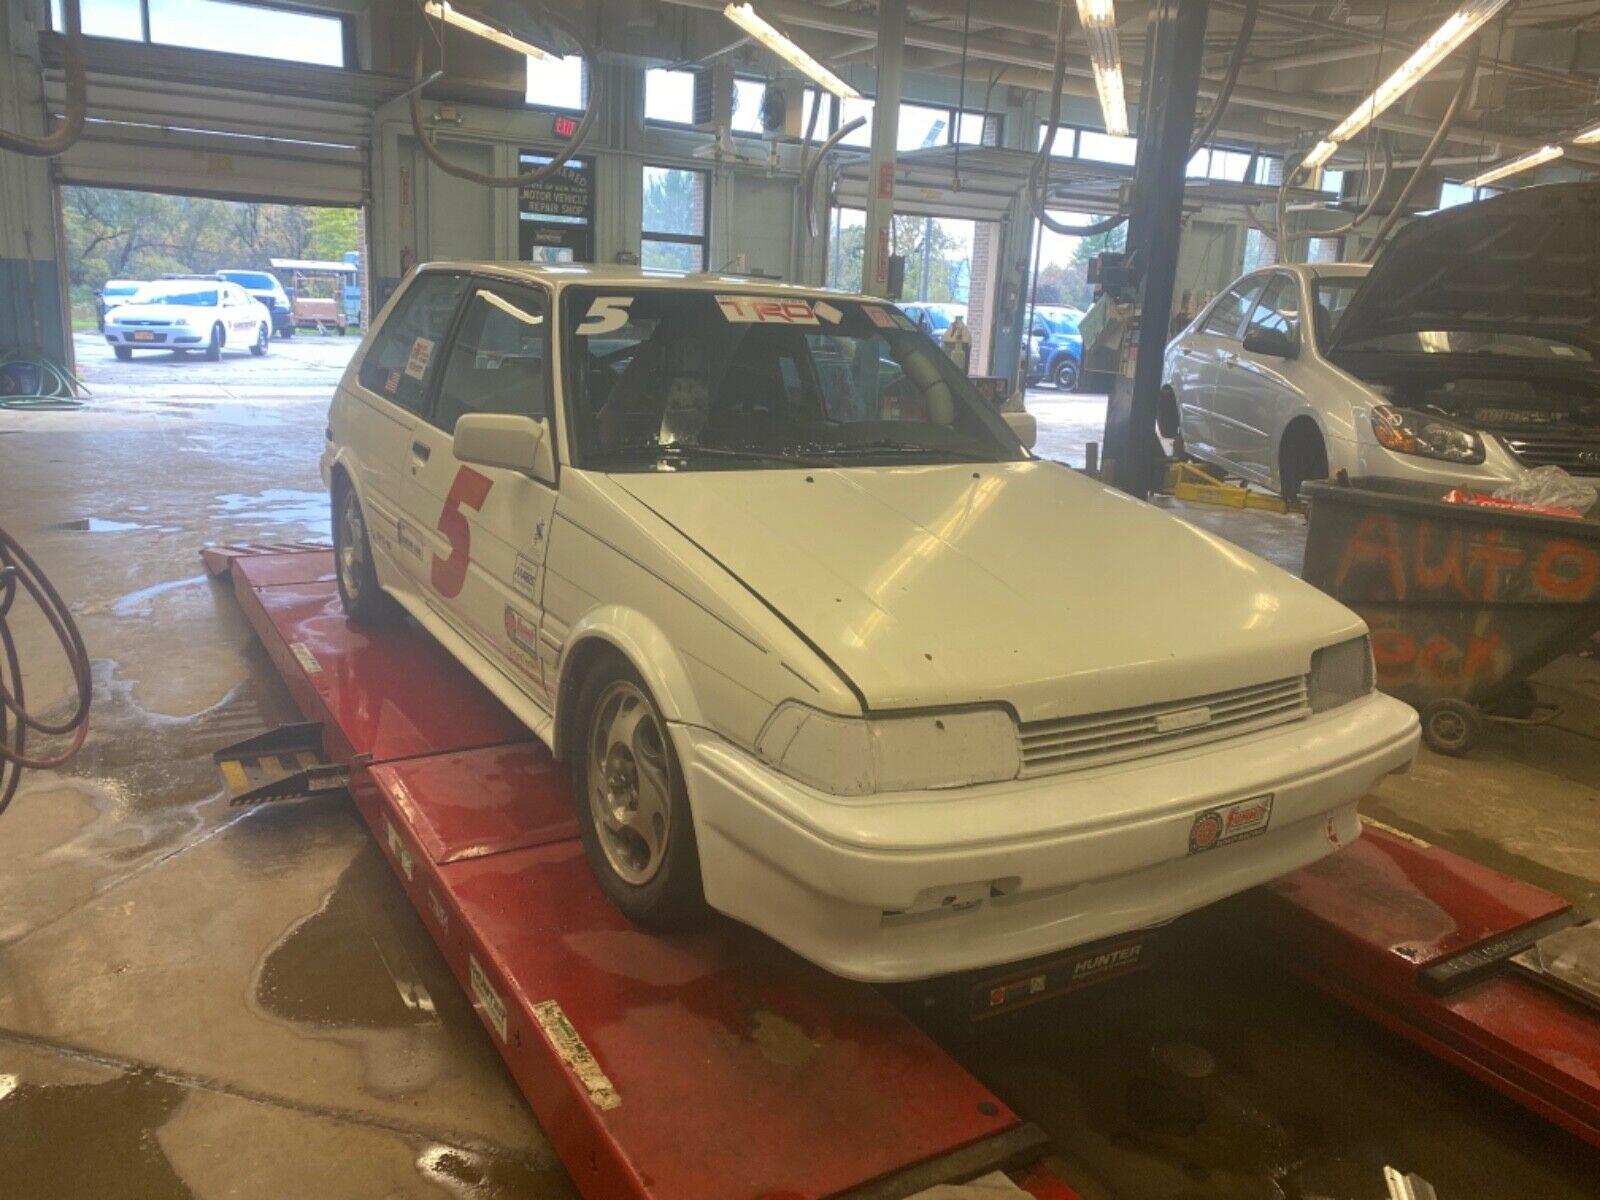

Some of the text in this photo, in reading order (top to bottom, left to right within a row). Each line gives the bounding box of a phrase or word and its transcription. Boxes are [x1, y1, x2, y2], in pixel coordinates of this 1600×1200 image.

[555, 117, 576, 136] EXIT
[523, 189, 588, 205] MOTOR VEHICLE
[528, 201, 584, 215] REPAIR SHOP
[575, 296, 634, 335] 5
[719, 301, 815, 322] TRD
[431, 464, 494, 599] 5
[1074, 945, 1142, 974] HUNTER
